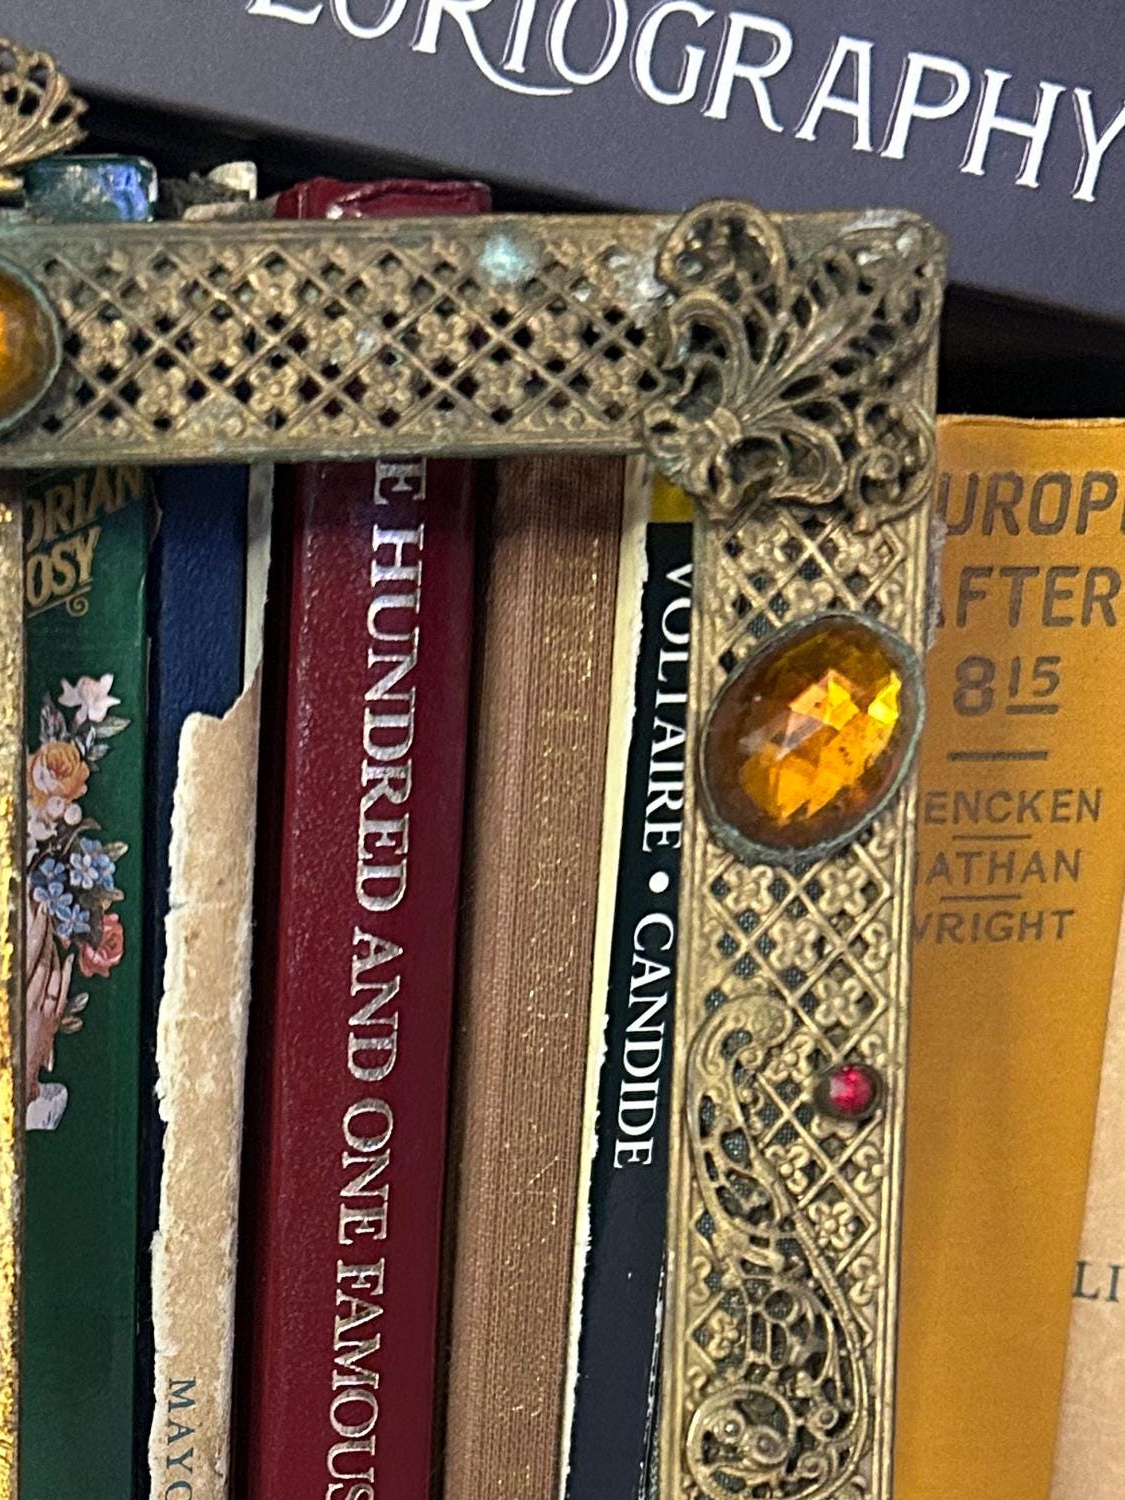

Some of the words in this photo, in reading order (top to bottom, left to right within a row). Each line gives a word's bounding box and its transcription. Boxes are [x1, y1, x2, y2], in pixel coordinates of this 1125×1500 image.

[245, 0, 1125, 202] RIOGRAPHY
[25, 527, 102, 607] OSY
[936, 471, 1125, 536] UROP
[937, 566, 1122, 628] FTER
[356, 523, 425, 912] HUNDRED
[347, 926, 402, 1082] AND
[613, 911, 675, 1171] CANDIDE
[337, 1098, 394, 1246] ONE
